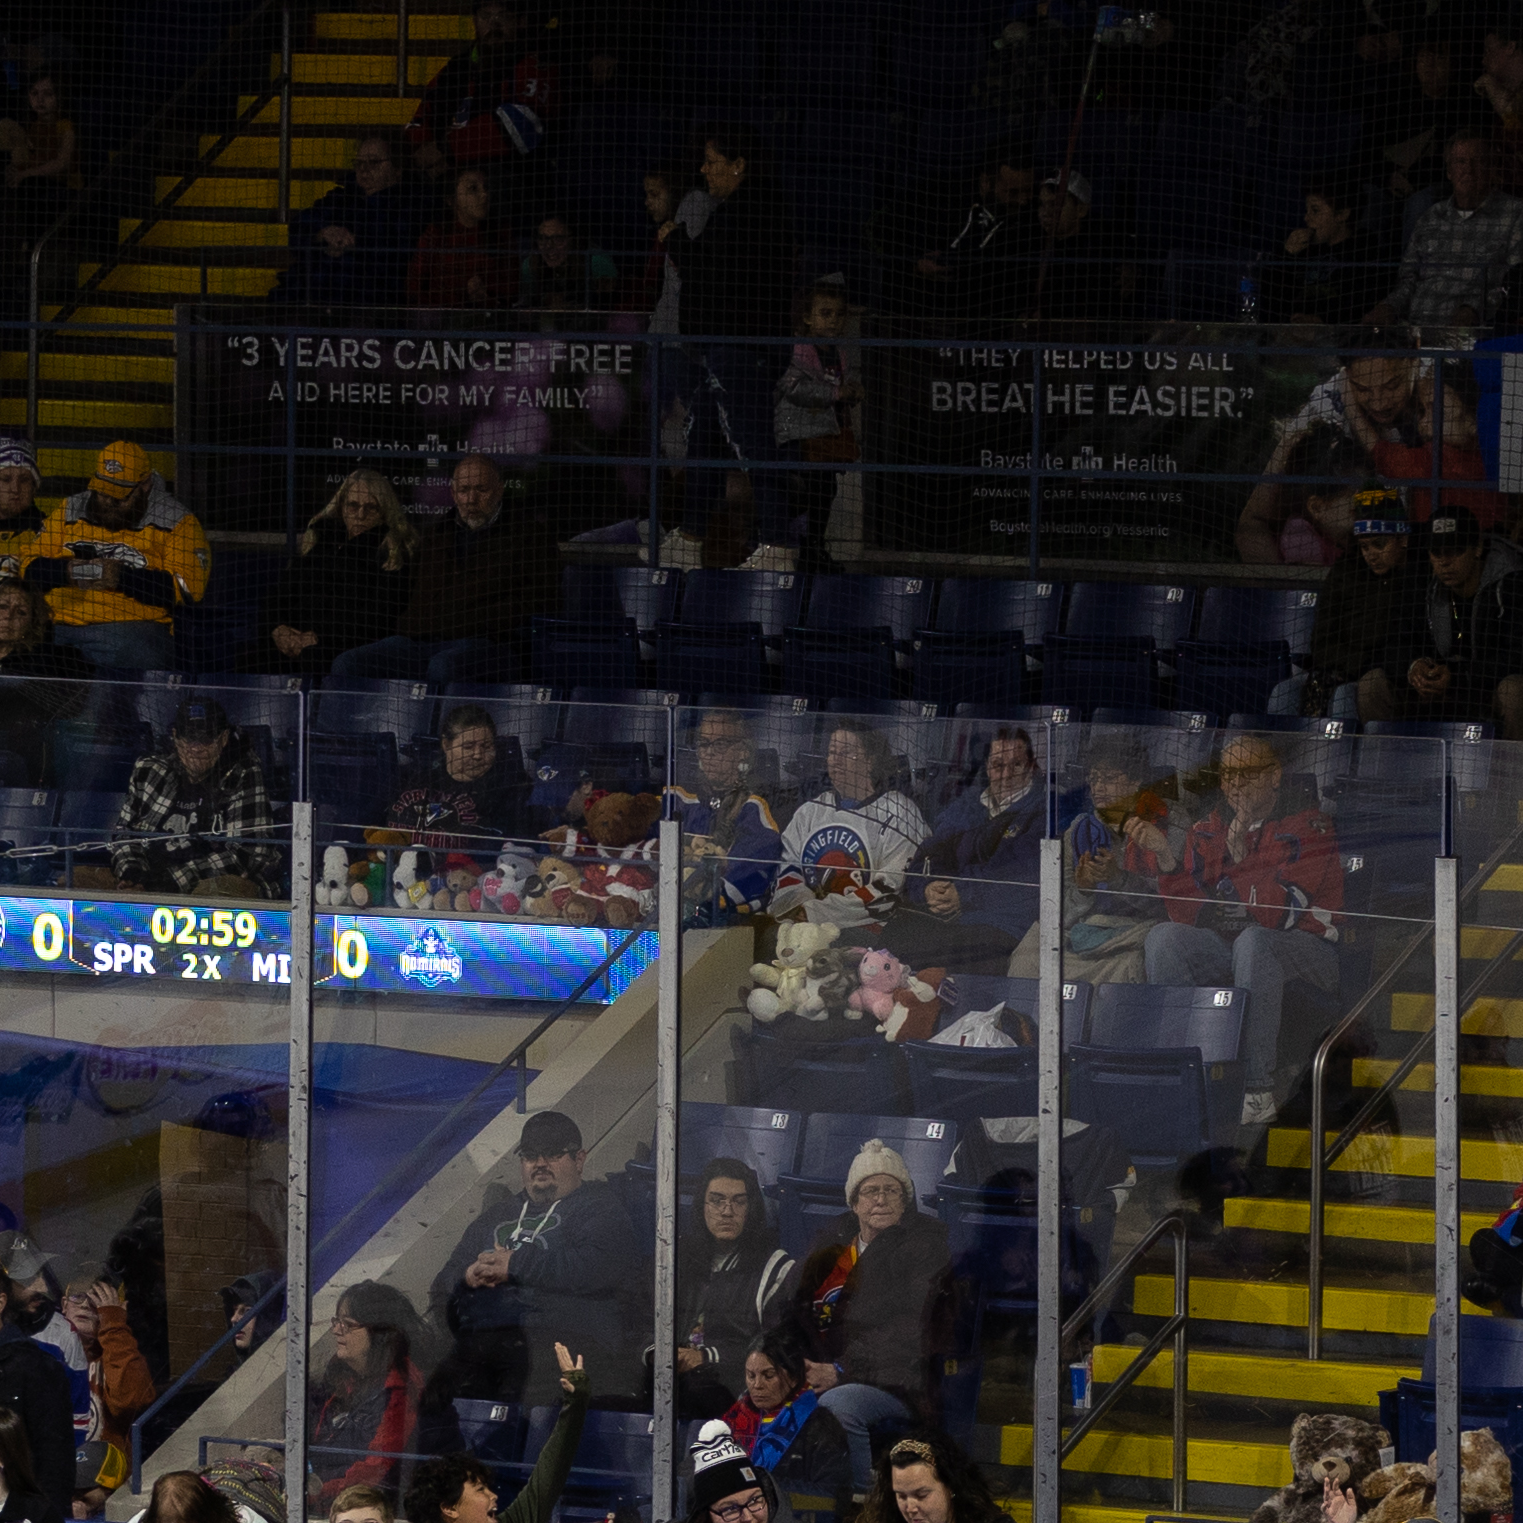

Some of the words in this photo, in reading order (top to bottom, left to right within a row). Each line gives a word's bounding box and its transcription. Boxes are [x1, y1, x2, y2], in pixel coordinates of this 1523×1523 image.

[272, 337, 382, 370] YEARS
[393, 339, 633, 375] CANCER-FREE
[1144, 352, 1178, 371] US
[1188, 352, 1235, 372] ALL
[329, 383, 393, 405] HERE
[401, 384, 450, 407] FOR
[459, 386, 495, 408] MY
[1113, 453, 1177, 473] Health
[973, 487, 1037, 499] ADVANCIN
[32, 912, 65, 962] 0
[152, 907, 258, 949] 02:59
[93, 941, 157, 975] SPR
[252, 952, 293, 986] MI
[337, 928, 370, 979] 0
[1218, 991, 1233, 1007] 15
[774, 1113, 787, 1129] 13
[927, 1122, 943, 1138] 14
